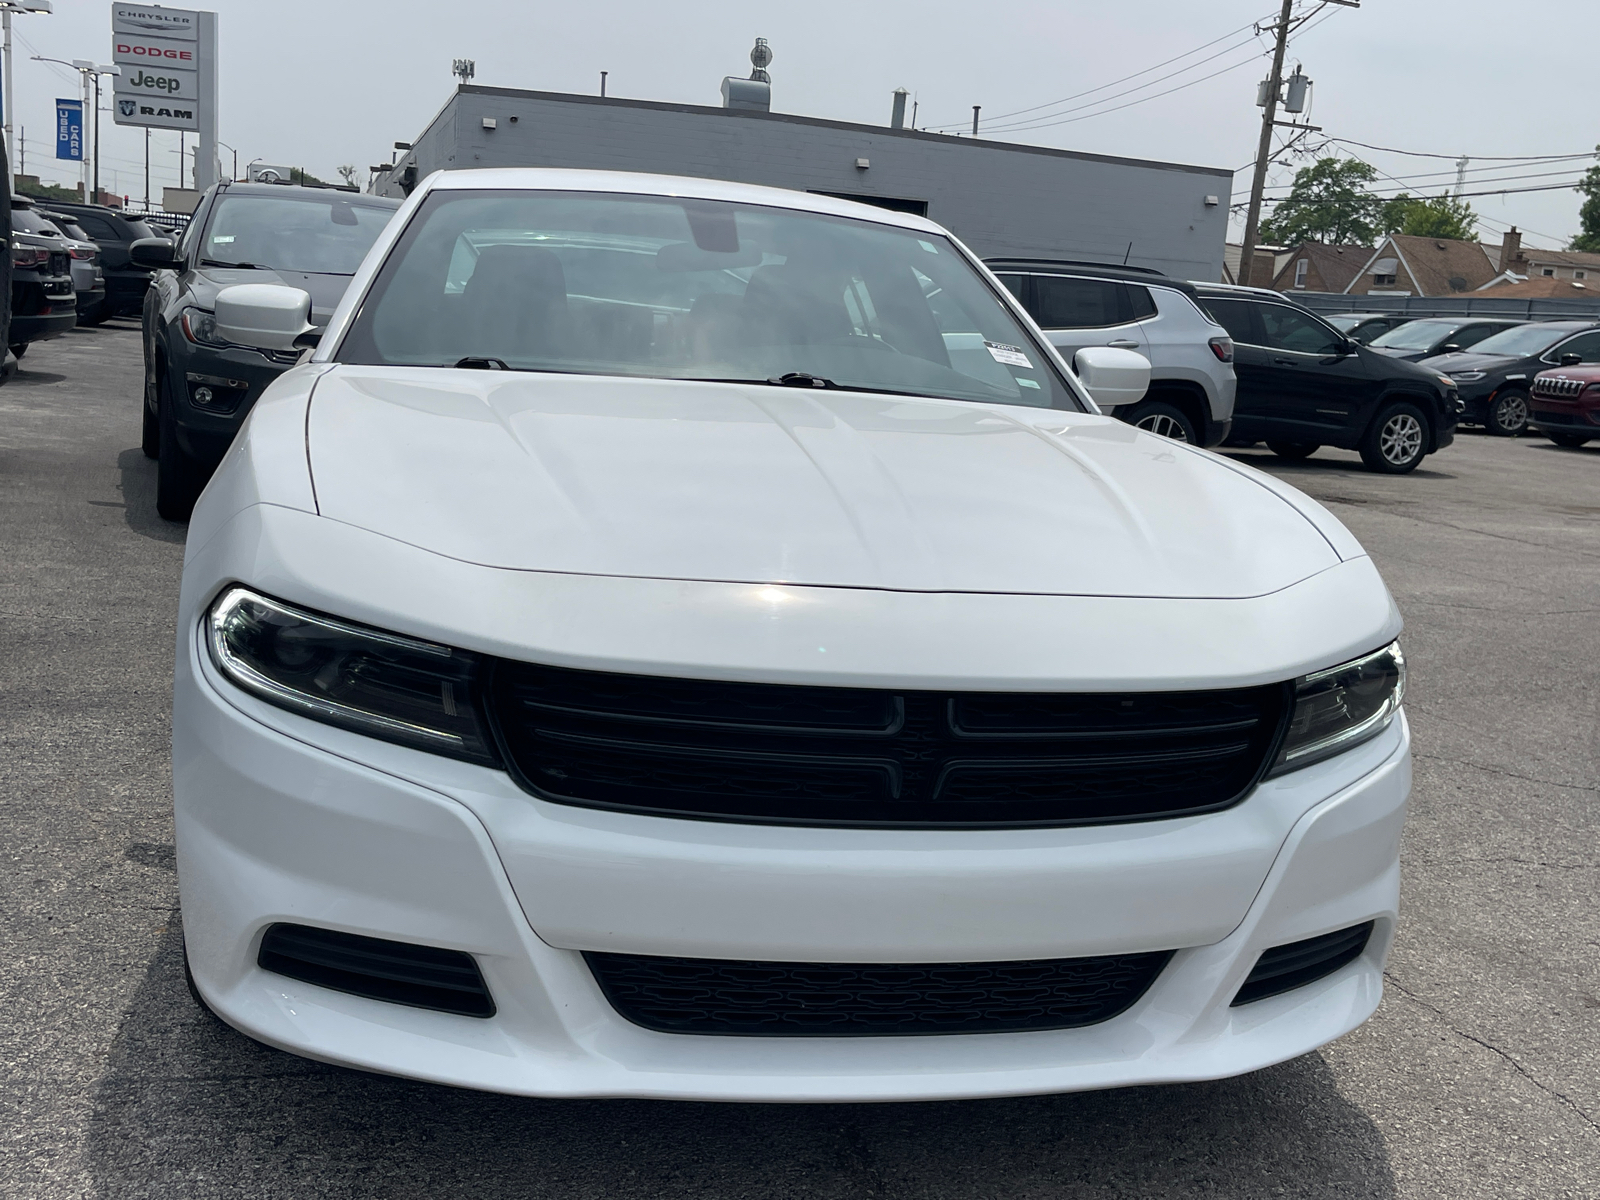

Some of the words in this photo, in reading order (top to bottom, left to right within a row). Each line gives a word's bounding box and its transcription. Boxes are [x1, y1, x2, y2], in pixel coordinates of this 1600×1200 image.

[118, 10, 190, 24] CHRYSLER
[117, 44, 192, 61] DODGE
[130, 70, 180, 94] Jeep
[140, 106, 193, 119] RAM
[60, 110, 69, 141] USED
[70, 125, 80, 156] CARS
